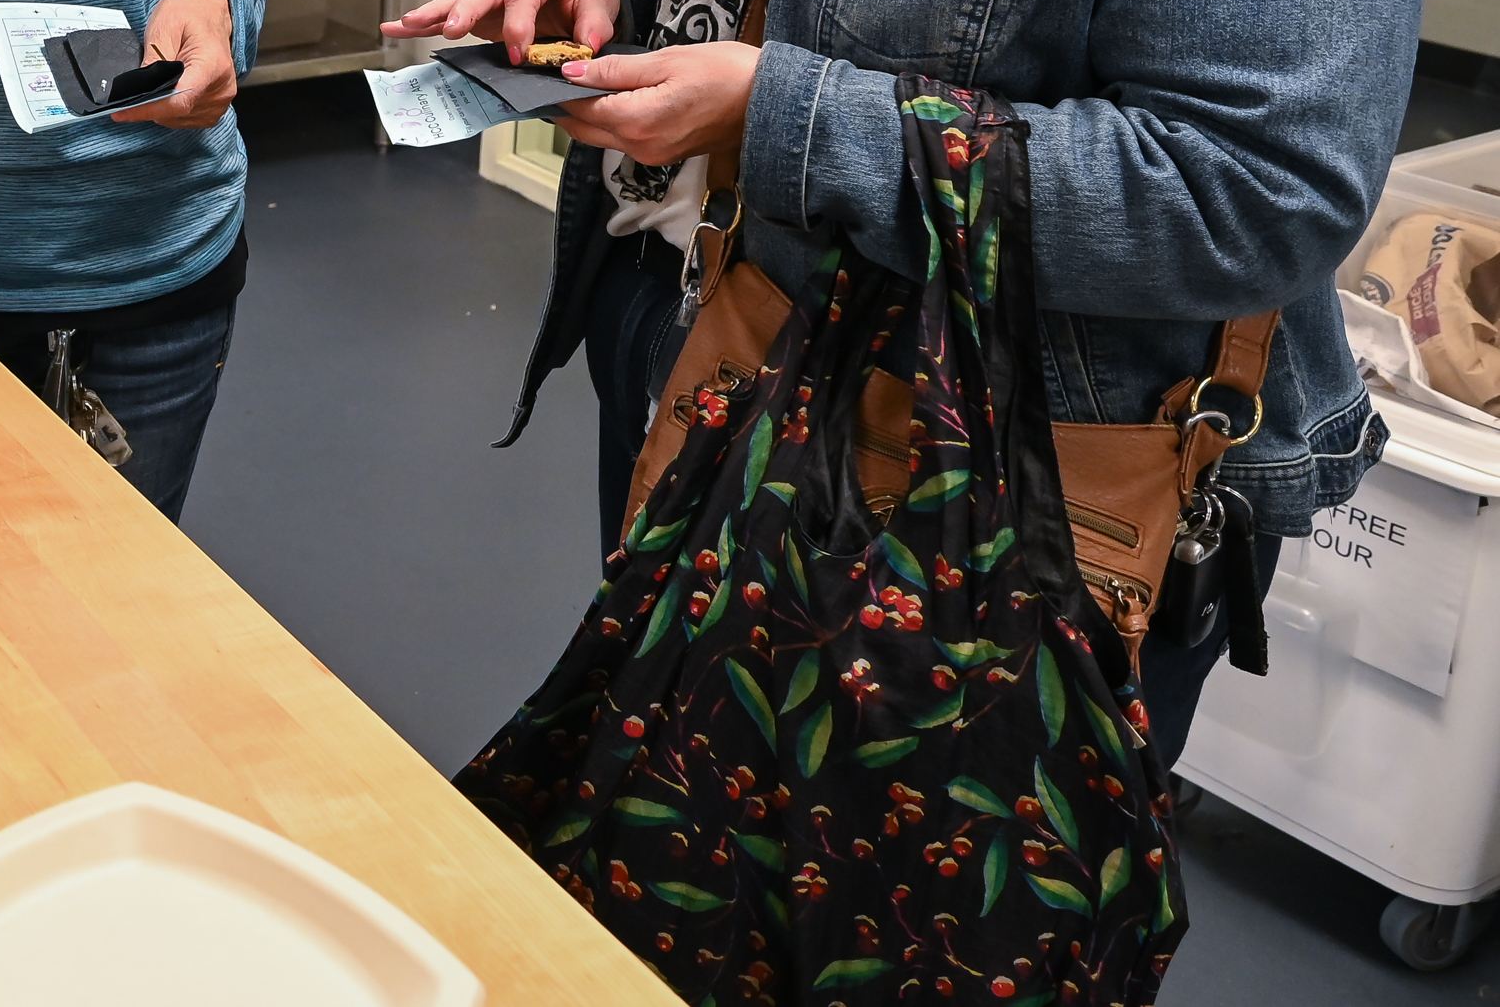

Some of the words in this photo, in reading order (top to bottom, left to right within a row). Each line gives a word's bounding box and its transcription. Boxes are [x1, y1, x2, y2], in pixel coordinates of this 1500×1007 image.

[410, 78, 423, 92] Arts
[428, 123, 444, 139] HCC
[1333, 503, 1408, 546] FREE
[1313, 528, 1373, 569] OUR
